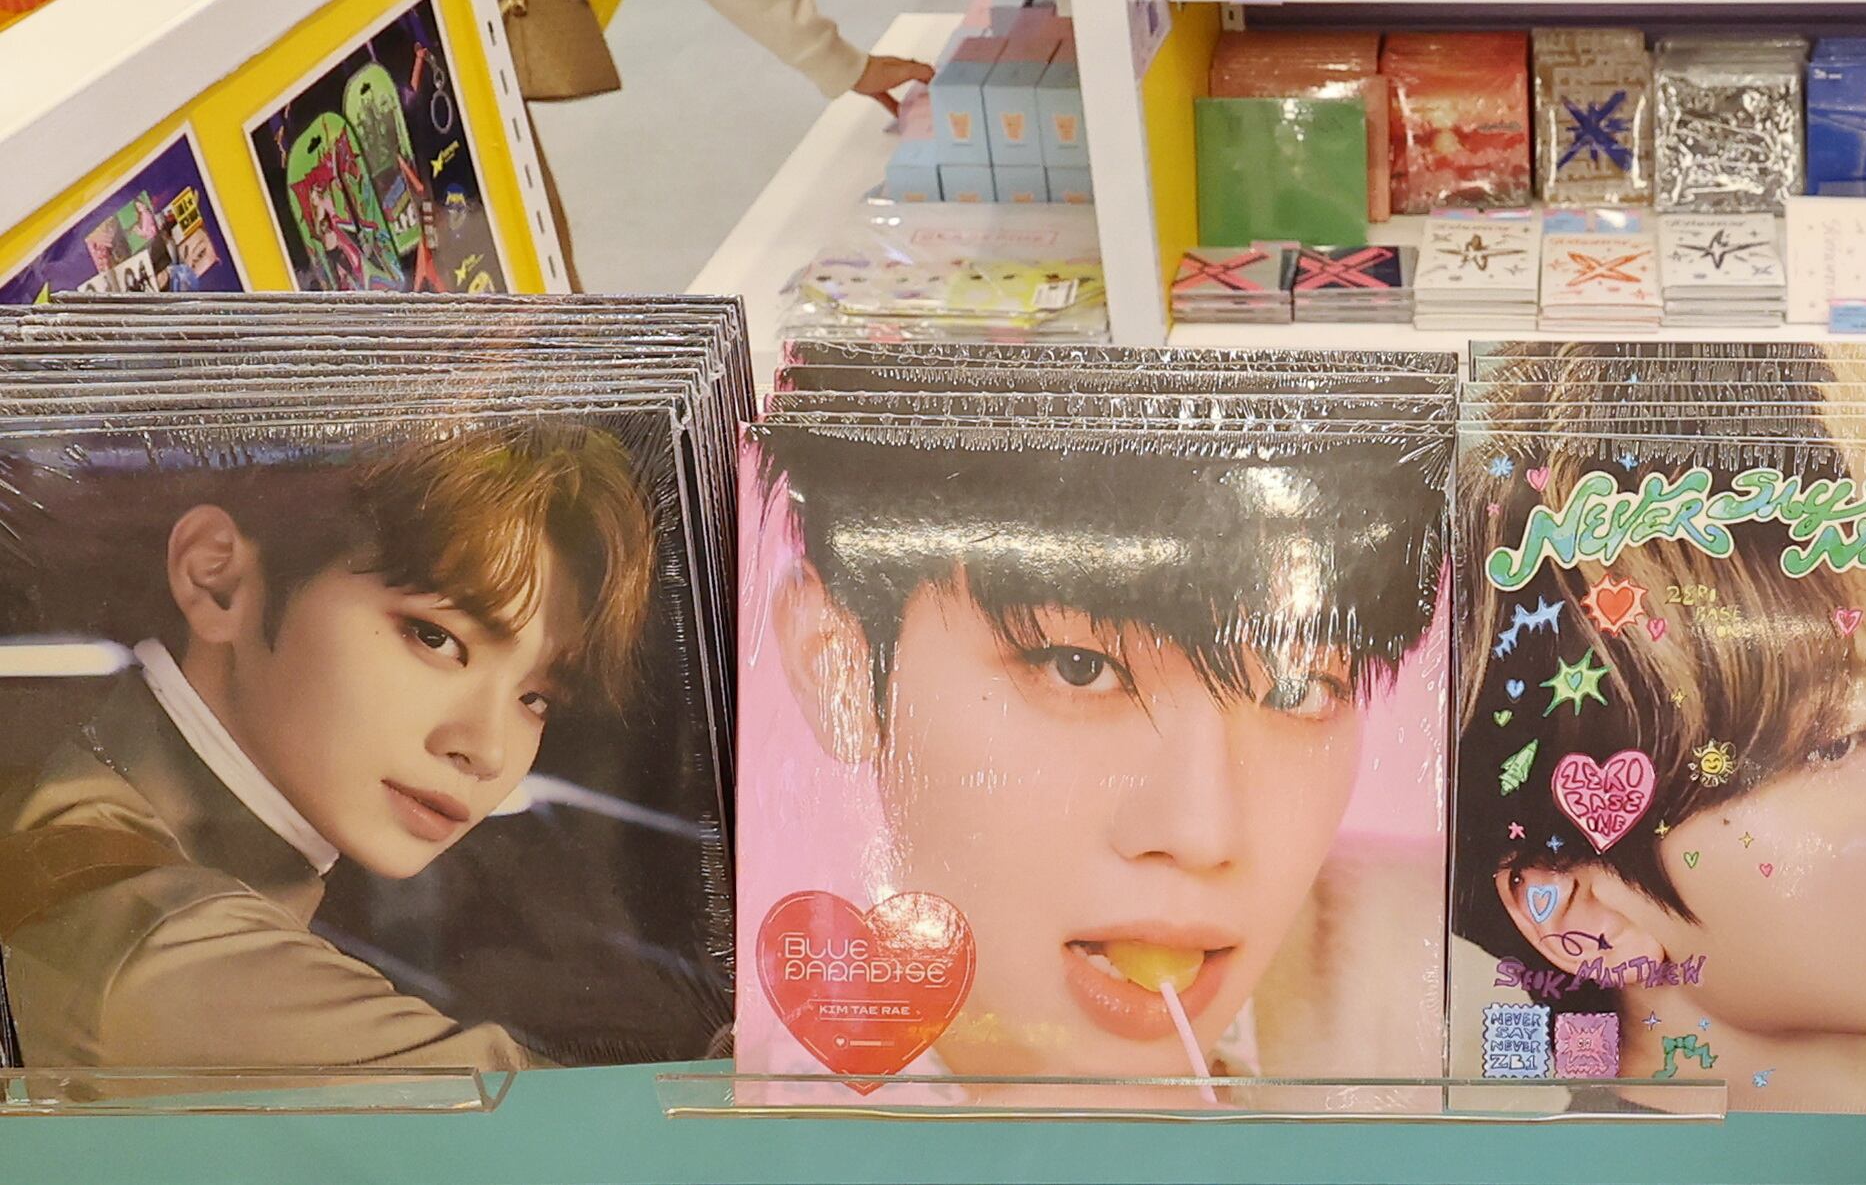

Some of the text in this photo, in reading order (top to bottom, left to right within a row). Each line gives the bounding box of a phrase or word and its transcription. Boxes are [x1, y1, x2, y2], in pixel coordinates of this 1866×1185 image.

[1488, 469, 1734, 591] NEVER
[1560, 758, 1644, 792] ZERO
[1563, 791, 1644, 817] BASE
[1587, 814, 1627, 837] ONE
[784, 937, 868, 959] BLUE
[784, 960, 947, 983] PARADISE
[1565, 954, 1708, 992] MATTHEW
[819, 1004, 910, 1016] KIM TAE RAE
[1490, 1012, 1541, 1027] NEVER
[1495, 1027, 1539, 1040] SAY
[1490, 1040, 1541, 1054] NEVER
[1490, 1055, 1538, 1070] ZB1
